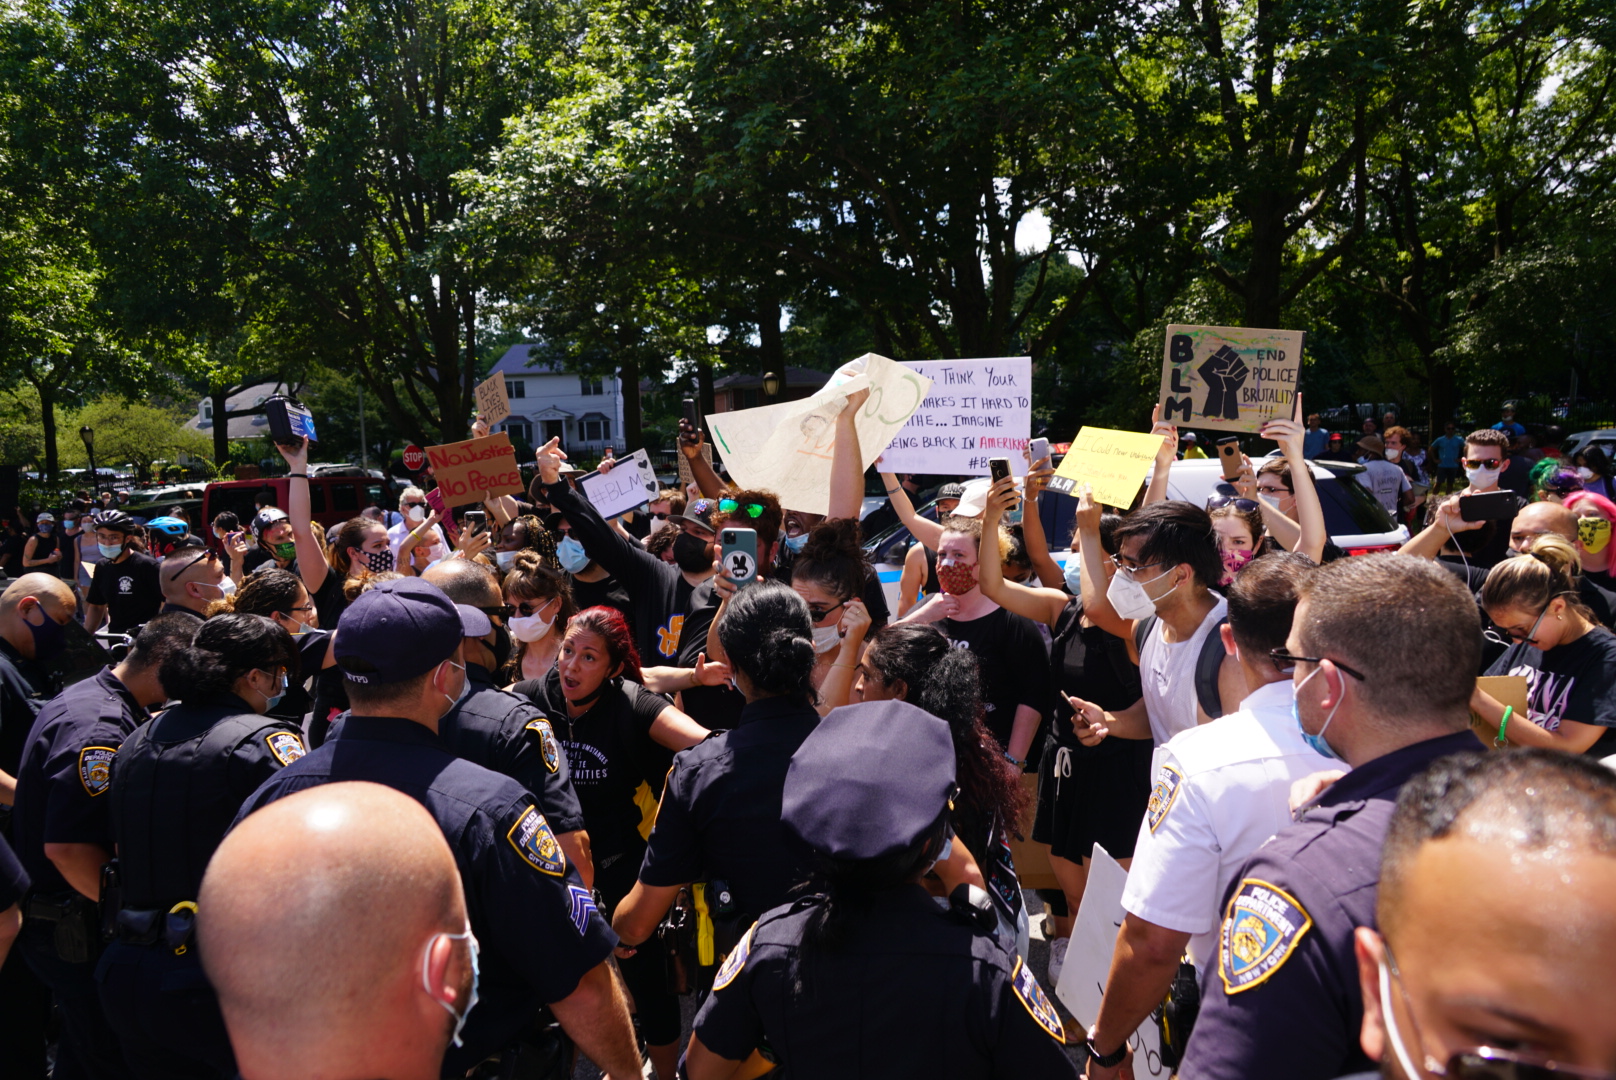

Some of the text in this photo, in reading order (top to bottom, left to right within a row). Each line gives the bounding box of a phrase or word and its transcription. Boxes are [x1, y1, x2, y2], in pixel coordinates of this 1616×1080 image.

[1257, 350, 1286, 361] END
[940, 368, 976, 386] THINK
[985, 367, 1017, 387] YOUR
[1164, 335, 1194, 422] BLM
[1253, 367, 1297, 383] POLICE
[961, 397, 977, 409] IT
[981, 397, 1012, 409] HARD
[1014, 396, 1029, 409] TO
[1243, 387, 1296, 404] BRUTALITY
[485, 402, 508, 425] ATTER
[952, 415, 1004, 428] IMAGINE
[922, 436, 956, 449] BLACK
[961, 437, 975, 450] IN
[404, 452, 423, 463] STOP
[462, 444, 515, 463] Justice
[467, 470, 521, 491] Peace
[1050, 476, 1074, 491] BLM
[590, 473, 645, 507] #BLM
[528, 852, 545, 867] CITY
[1250, 886, 1290, 915] POLICE
[1238, 941, 1288, 984] NEW YORK
